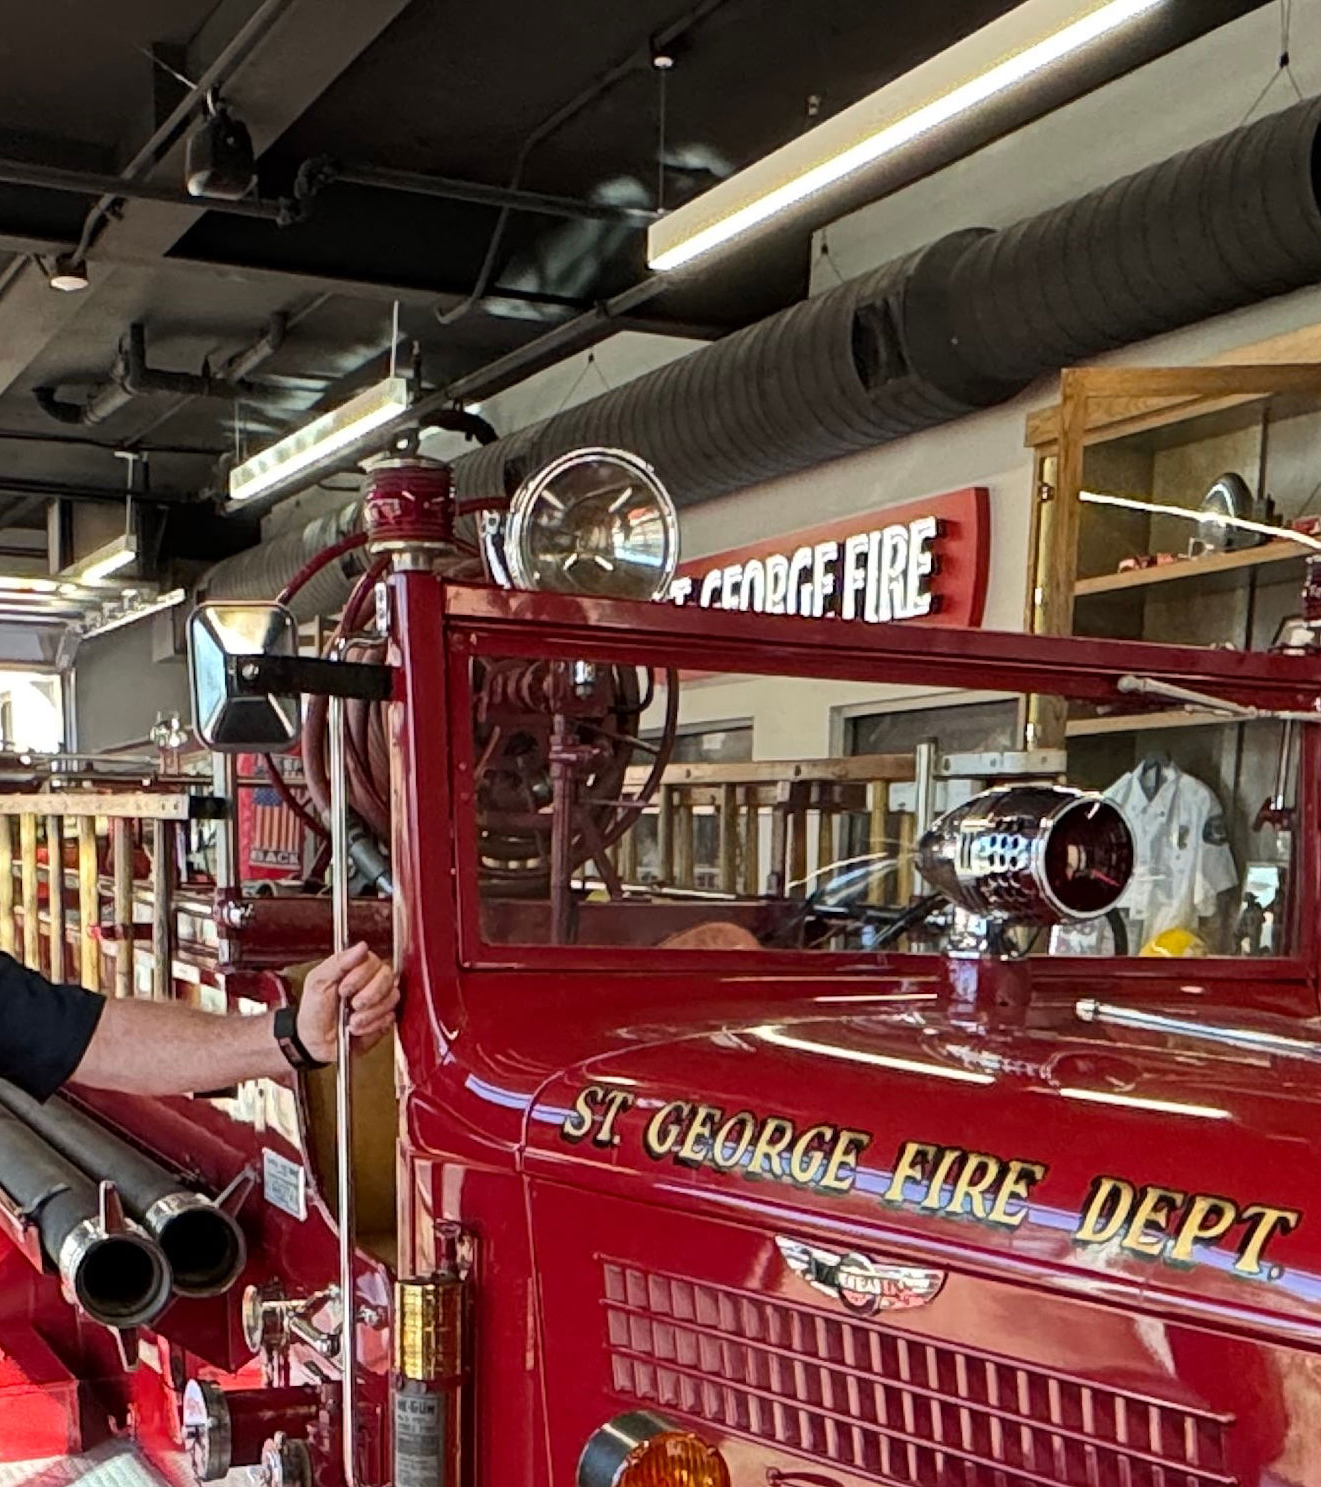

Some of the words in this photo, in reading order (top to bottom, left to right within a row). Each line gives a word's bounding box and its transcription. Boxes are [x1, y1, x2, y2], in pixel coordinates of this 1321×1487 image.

[841, 516, 937, 624] FIRE
[563, 1085, 634, 1145] ST.
[645, 1099, 870, 1194] GEORGE
[882, 1141, 1046, 1230] FIRE
[1075, 1174, 1300, 1283] DEPT.
